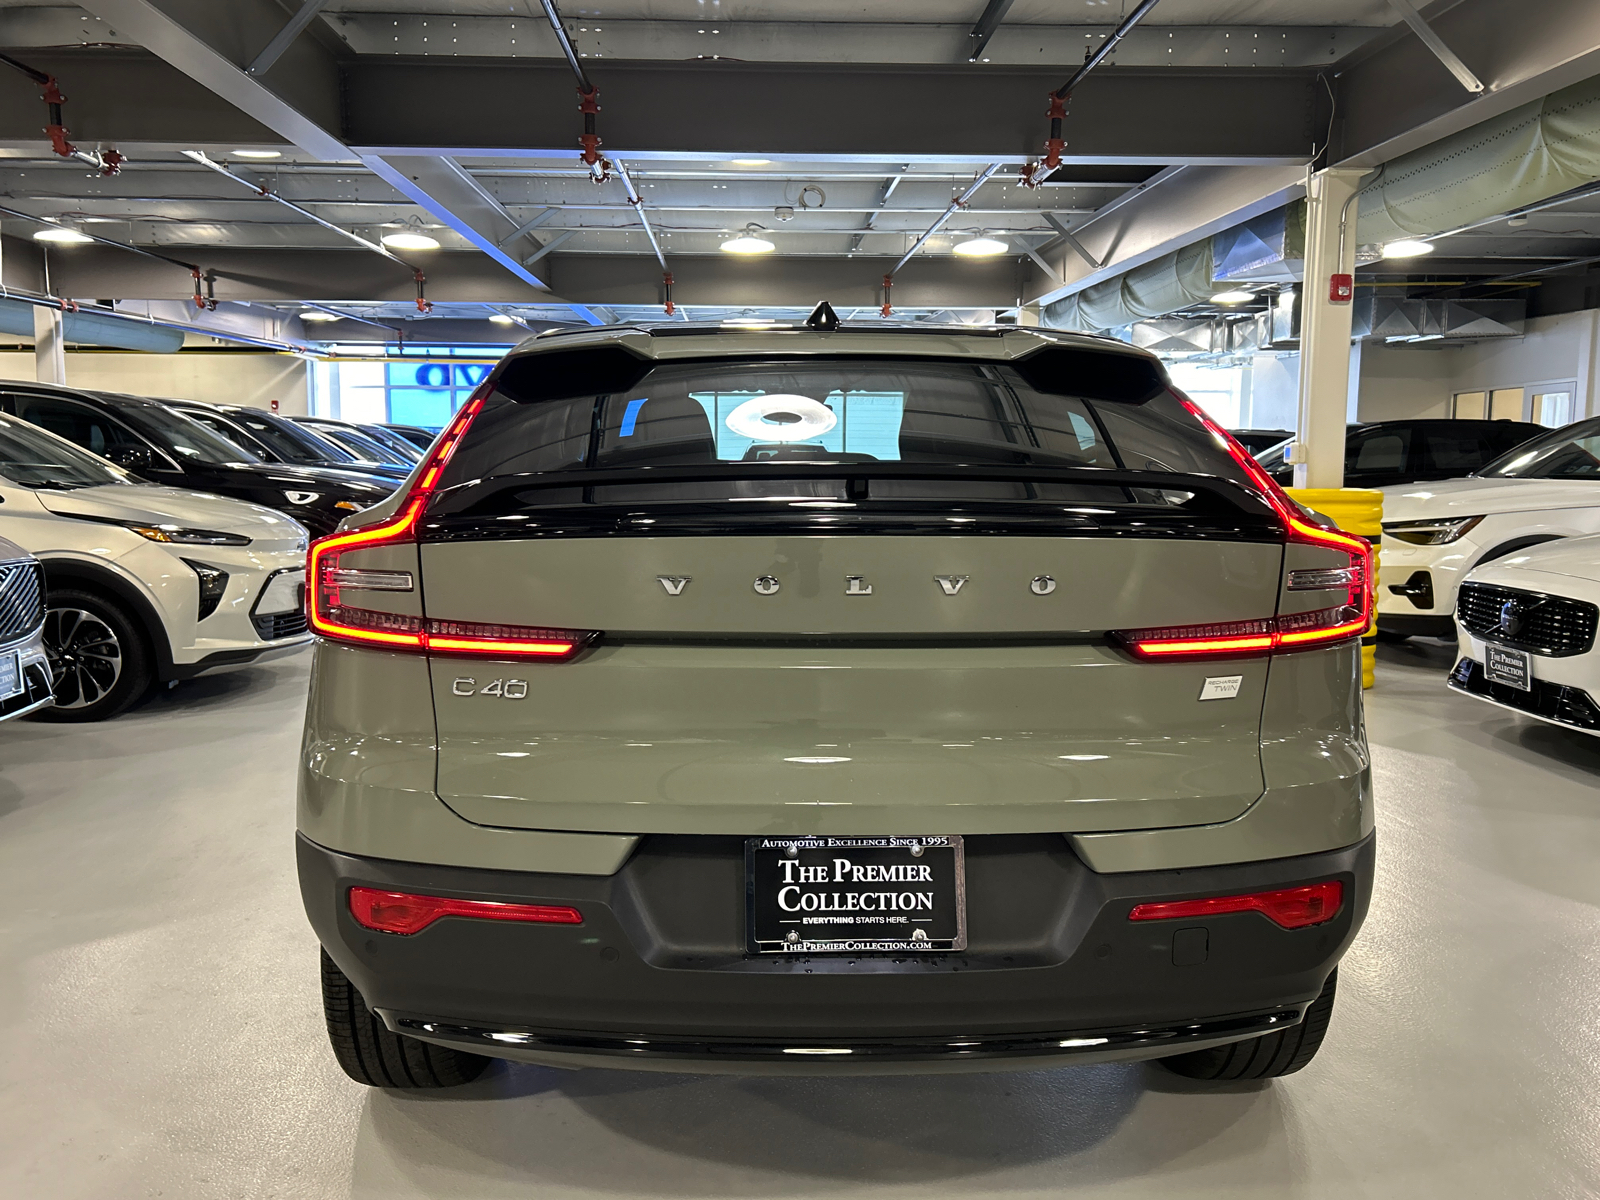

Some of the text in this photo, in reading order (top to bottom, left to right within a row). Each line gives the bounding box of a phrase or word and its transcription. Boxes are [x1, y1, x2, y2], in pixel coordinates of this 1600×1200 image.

[656, 574, 1057, 596] VOLVO
[1490, 660, 1524, 676] COLLECTION
[761, 837, 949, 848] AUTOMOTIVE EXCELLENCE SINCE 1995
[777, 858, 934, 884] THE PREMIER
[777, 885, 934, 912] COLLECTION
[802, 916, 909, 925] EVERYTHING STARTS HERE.
